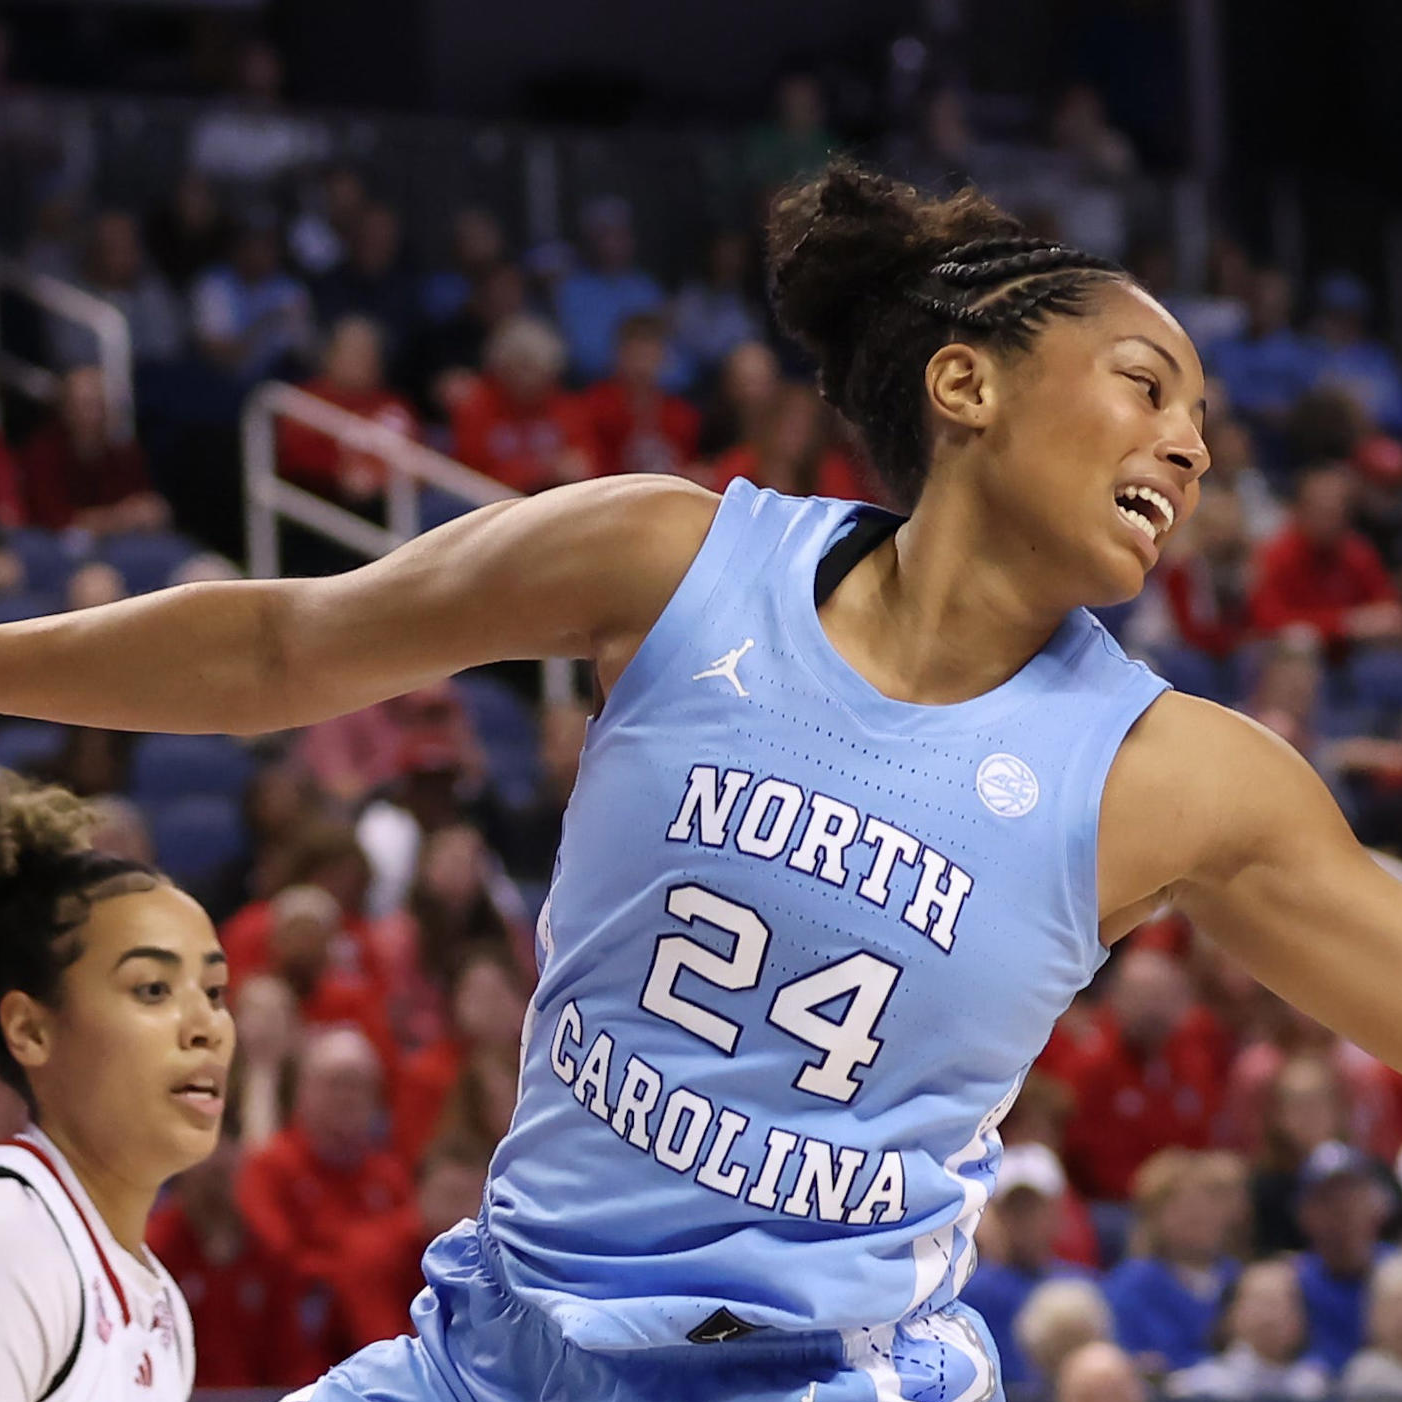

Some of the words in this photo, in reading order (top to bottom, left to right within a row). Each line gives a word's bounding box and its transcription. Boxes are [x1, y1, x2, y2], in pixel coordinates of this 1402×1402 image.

[666, 765, 974, 954] NORTH
[640, 882, 904, 1105] 24
[549, 999, 908, 1226] CAROLINA
